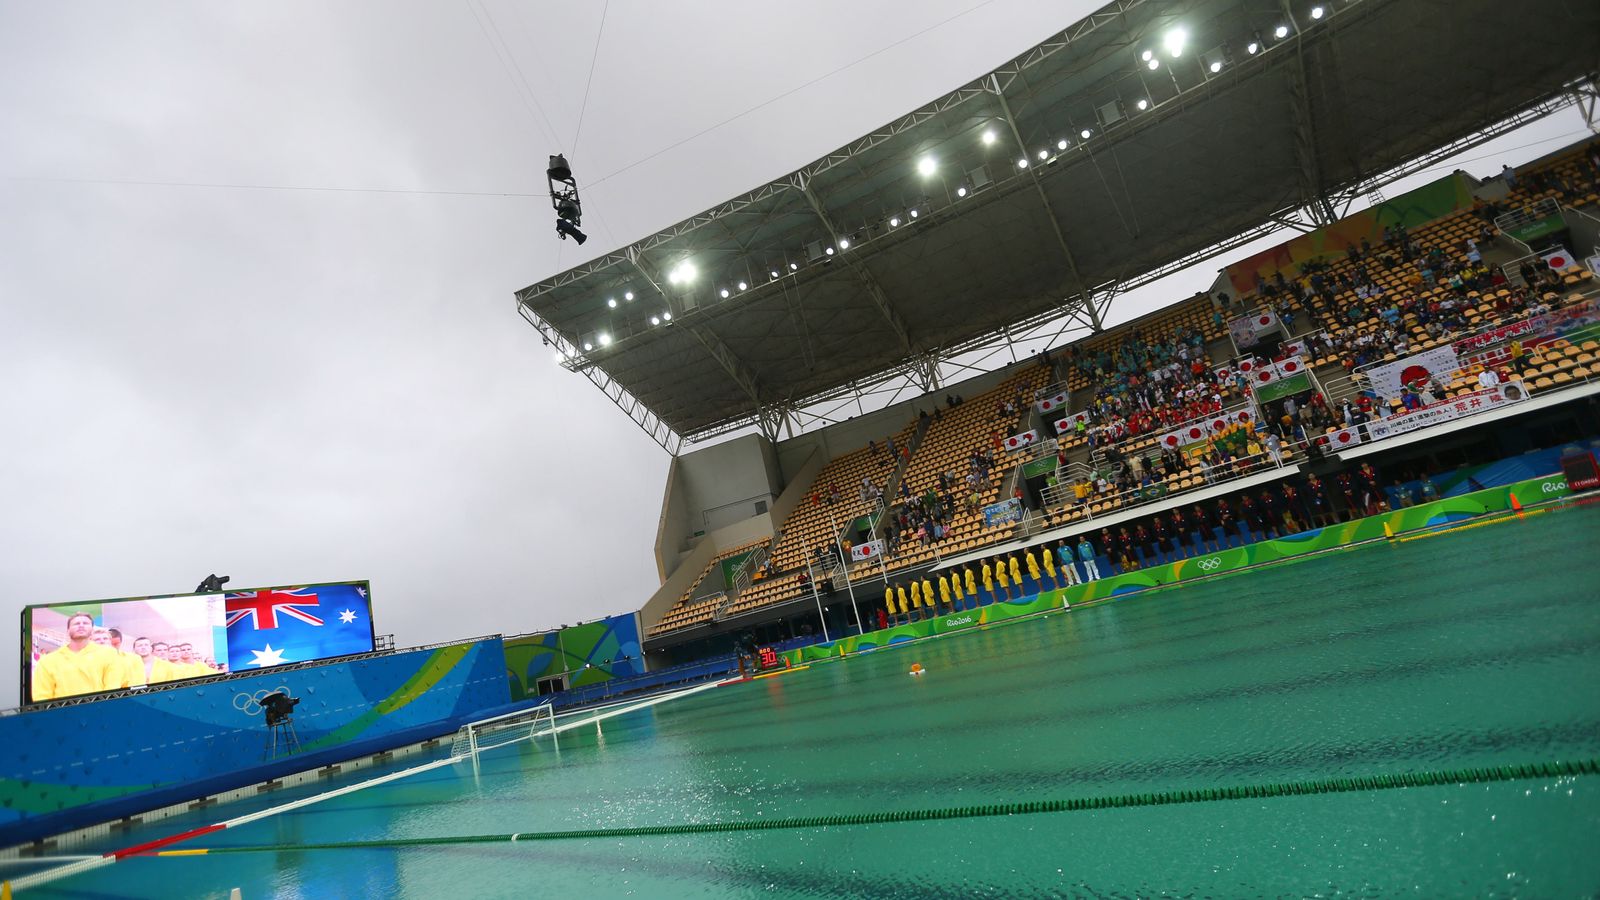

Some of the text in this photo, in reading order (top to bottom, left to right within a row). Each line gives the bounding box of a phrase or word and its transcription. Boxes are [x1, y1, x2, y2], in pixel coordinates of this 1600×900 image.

[1542, 482, 1568, 493] Rio
[946, 616, 972, 627] Rio2016
[761, 651, 777, 664] 30
